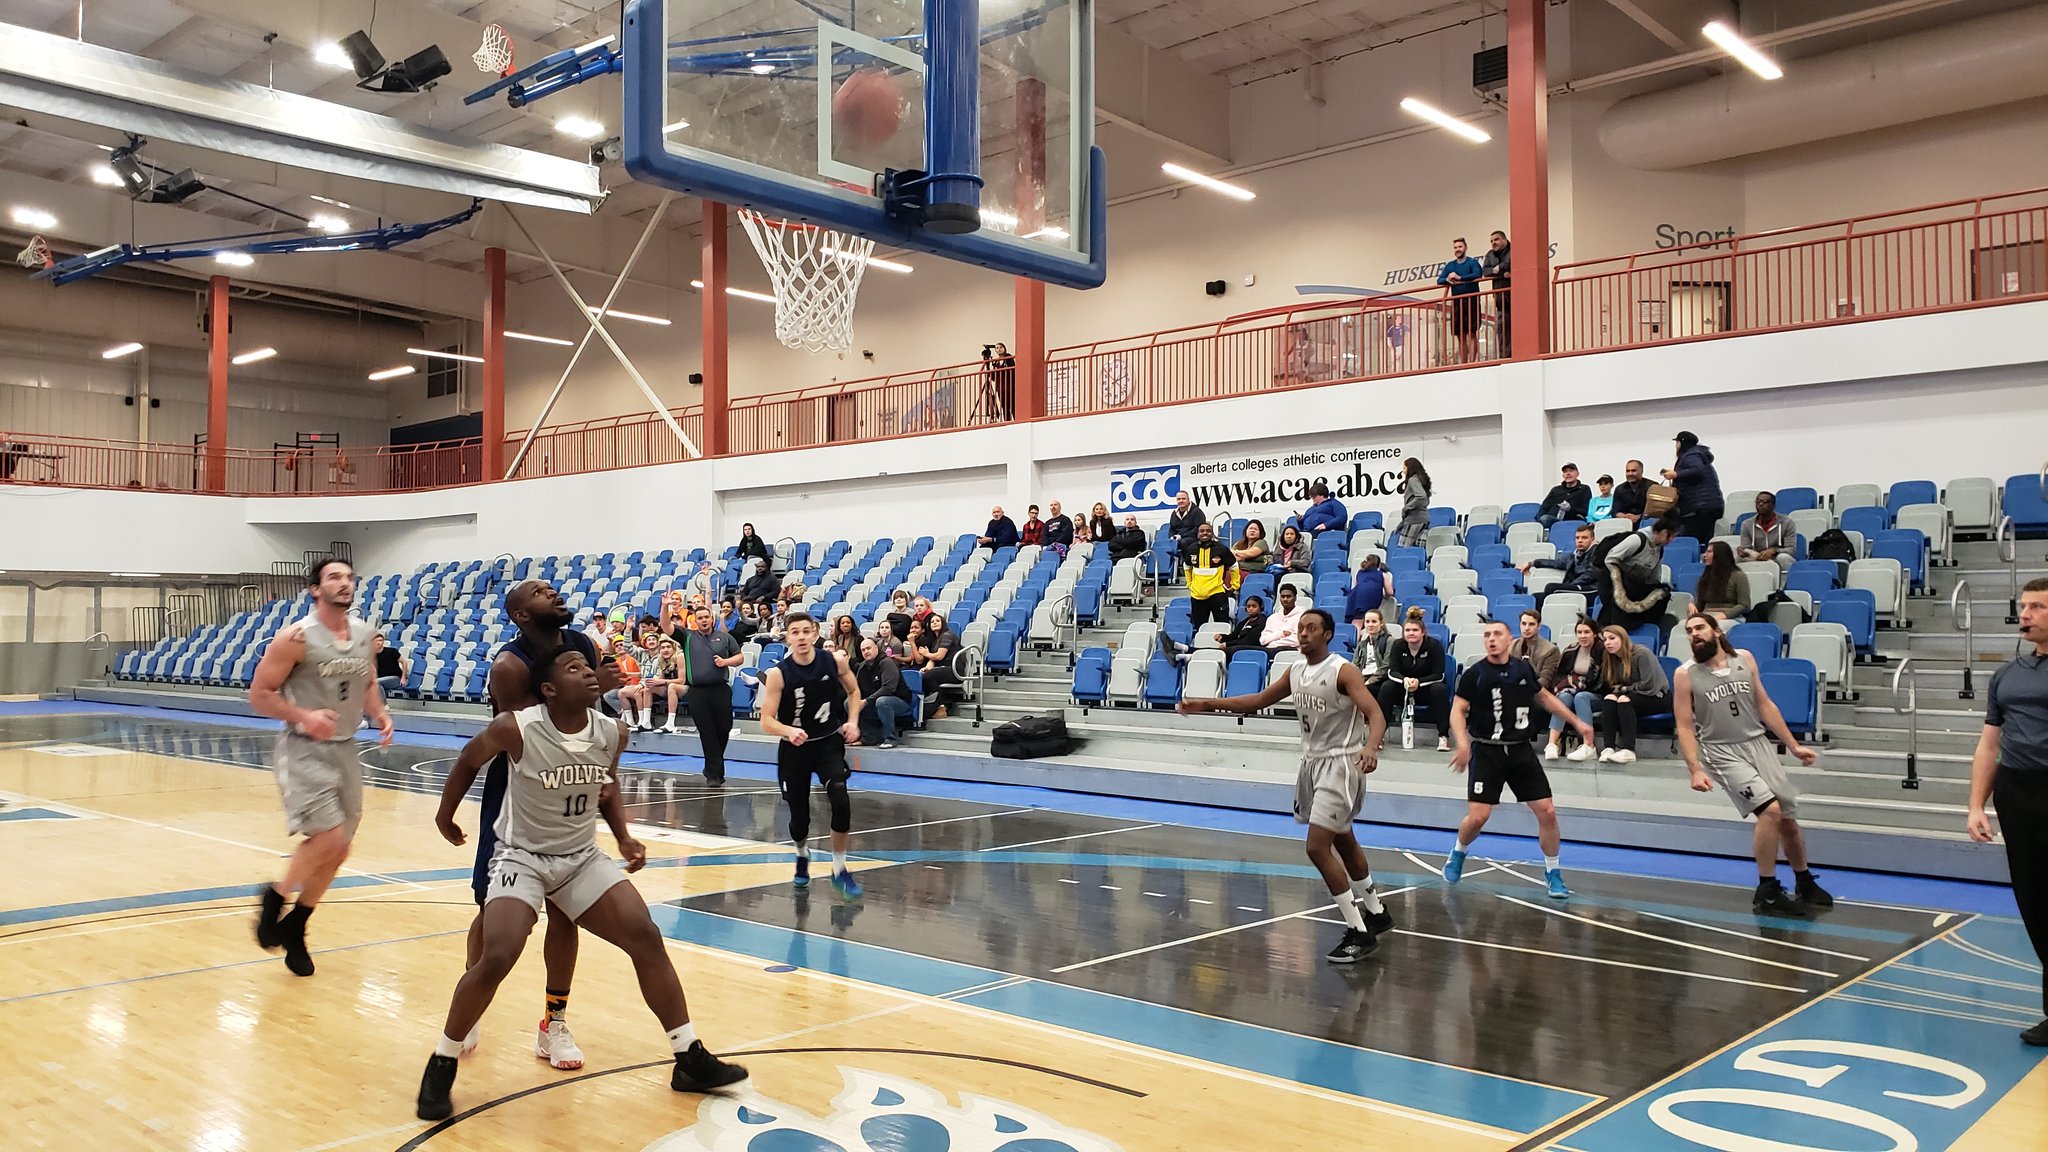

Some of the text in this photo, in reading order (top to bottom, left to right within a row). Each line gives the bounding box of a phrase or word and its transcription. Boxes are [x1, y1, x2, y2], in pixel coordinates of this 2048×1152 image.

[1655, 223, 1735, 256] Sport
[1383, 262, 1447, 286] HUSKIE
[1190, 447, 1401, 475] alberta colleges athletic conference
[1111, 468, 1179, 510] acac
[1703, 681, 1750, 703] WOLVES
[813, 701, 831, 723] 4
[1515, 706, 1530, 730] 5
[1729, 701, 1740, 717] 9
[1302, 714, 1311, 733] 5
[540, 764, 610, 790] WOLVES
[562, 794, 588, 817] 10
[501, 872, 519, 888] W
